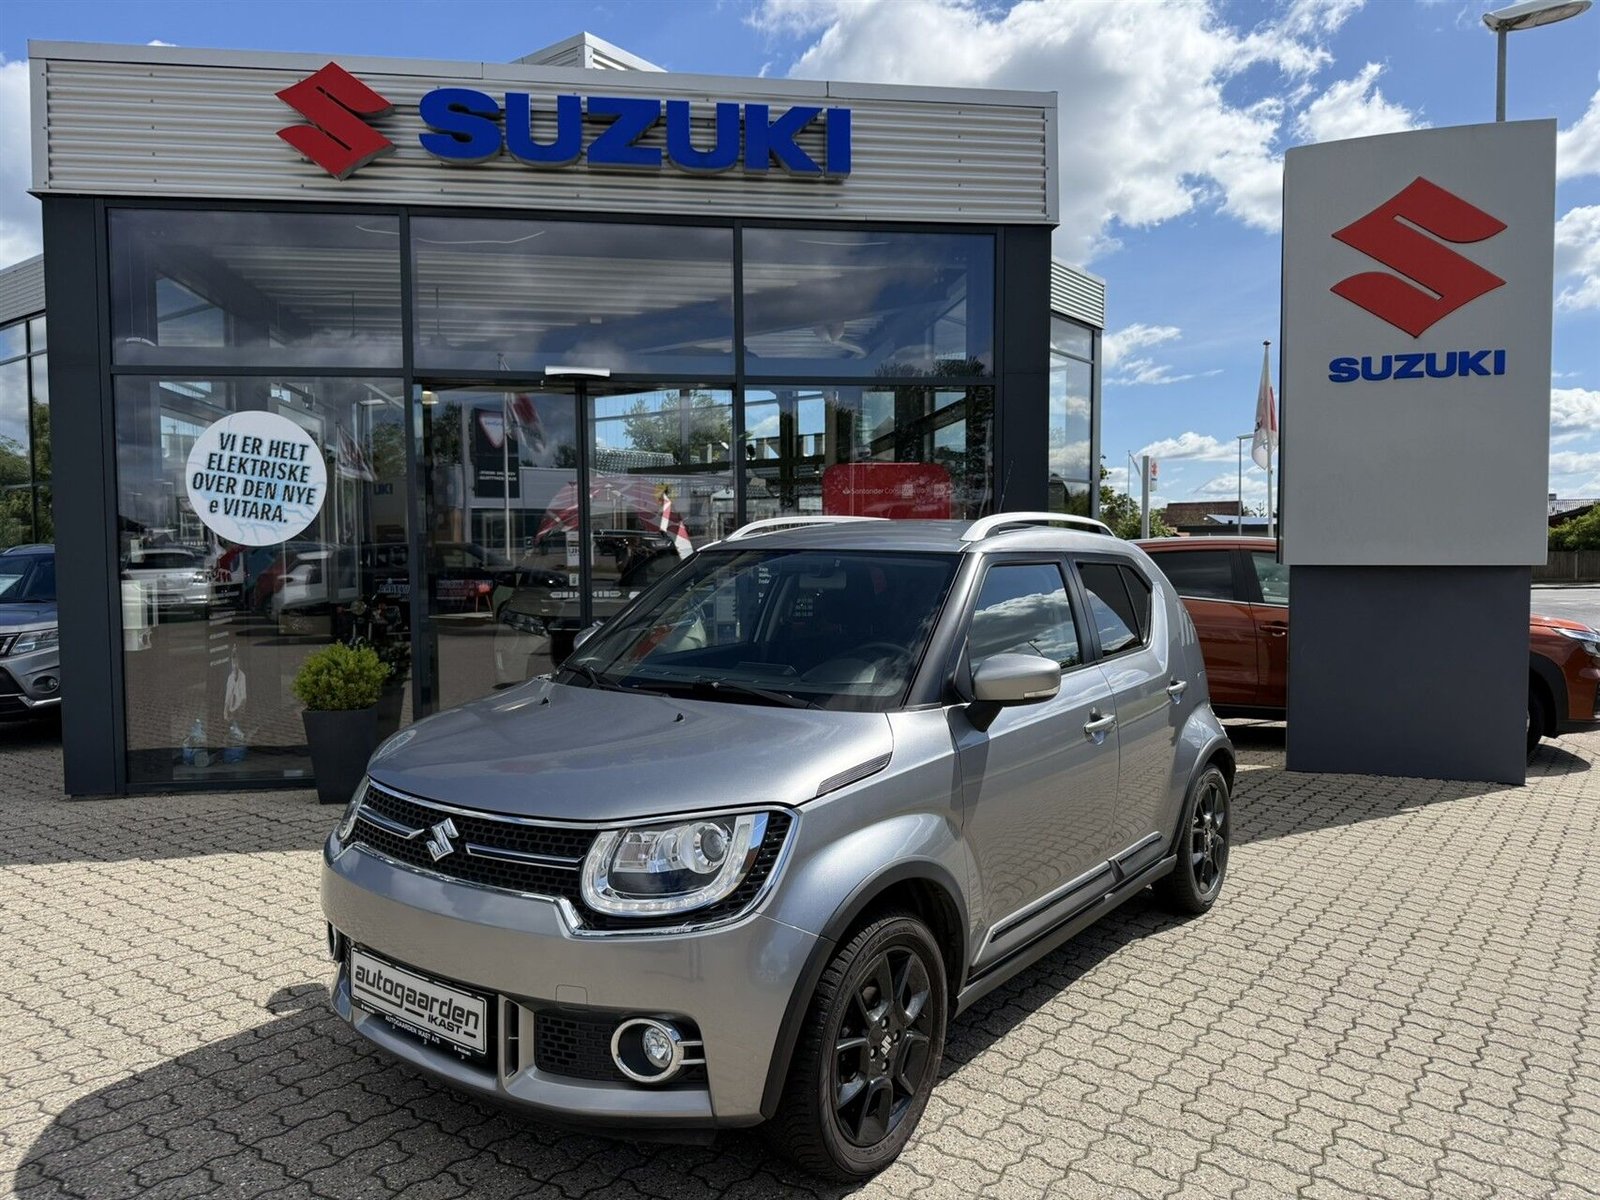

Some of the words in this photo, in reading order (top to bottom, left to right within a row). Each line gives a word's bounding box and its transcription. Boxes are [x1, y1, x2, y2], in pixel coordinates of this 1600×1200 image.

[419, 88, 851, 178] SUZUKI
[1328, 349, 1506, 383] SUZUKI
[220, 432, 237, 452] VI
[241, 436, 263, 456] ER
[268, 440, 309, 462] HELT
[207, 453, 311, 483] ELEKTRISKE
[192, 472, 237, 495] OVER
[243, 479, 278, 500] DEN
[282, 486, 317, 506] NYE
[851, 487, 884, 495] Santander
[209, 499, 219, 514] e
[223, 498, 288, 523] VITARA.
[355, 965, 480, 1030] autogaarden
[427, 1013, 462, 1035] IKAST
